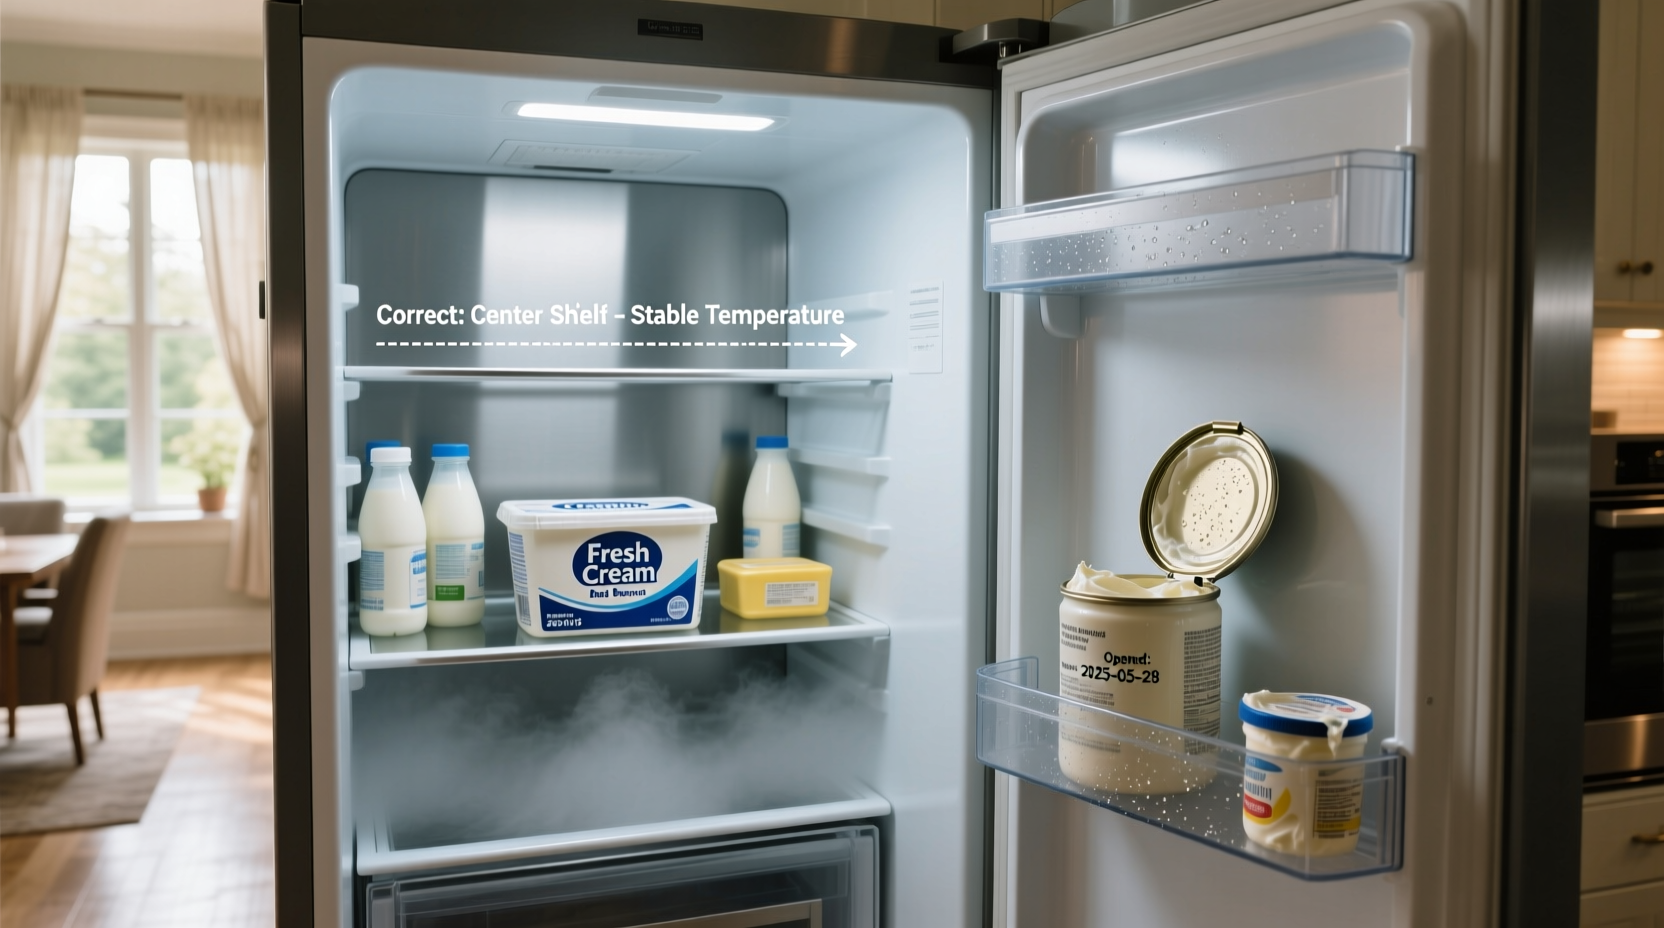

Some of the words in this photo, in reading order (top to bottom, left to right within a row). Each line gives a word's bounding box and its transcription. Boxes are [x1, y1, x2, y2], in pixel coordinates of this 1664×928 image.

[587, 541, 650, 564] Fresh
[582, 565, 656, 585] Cream
[1080, 664, 1160, 684] 2025-05-28
